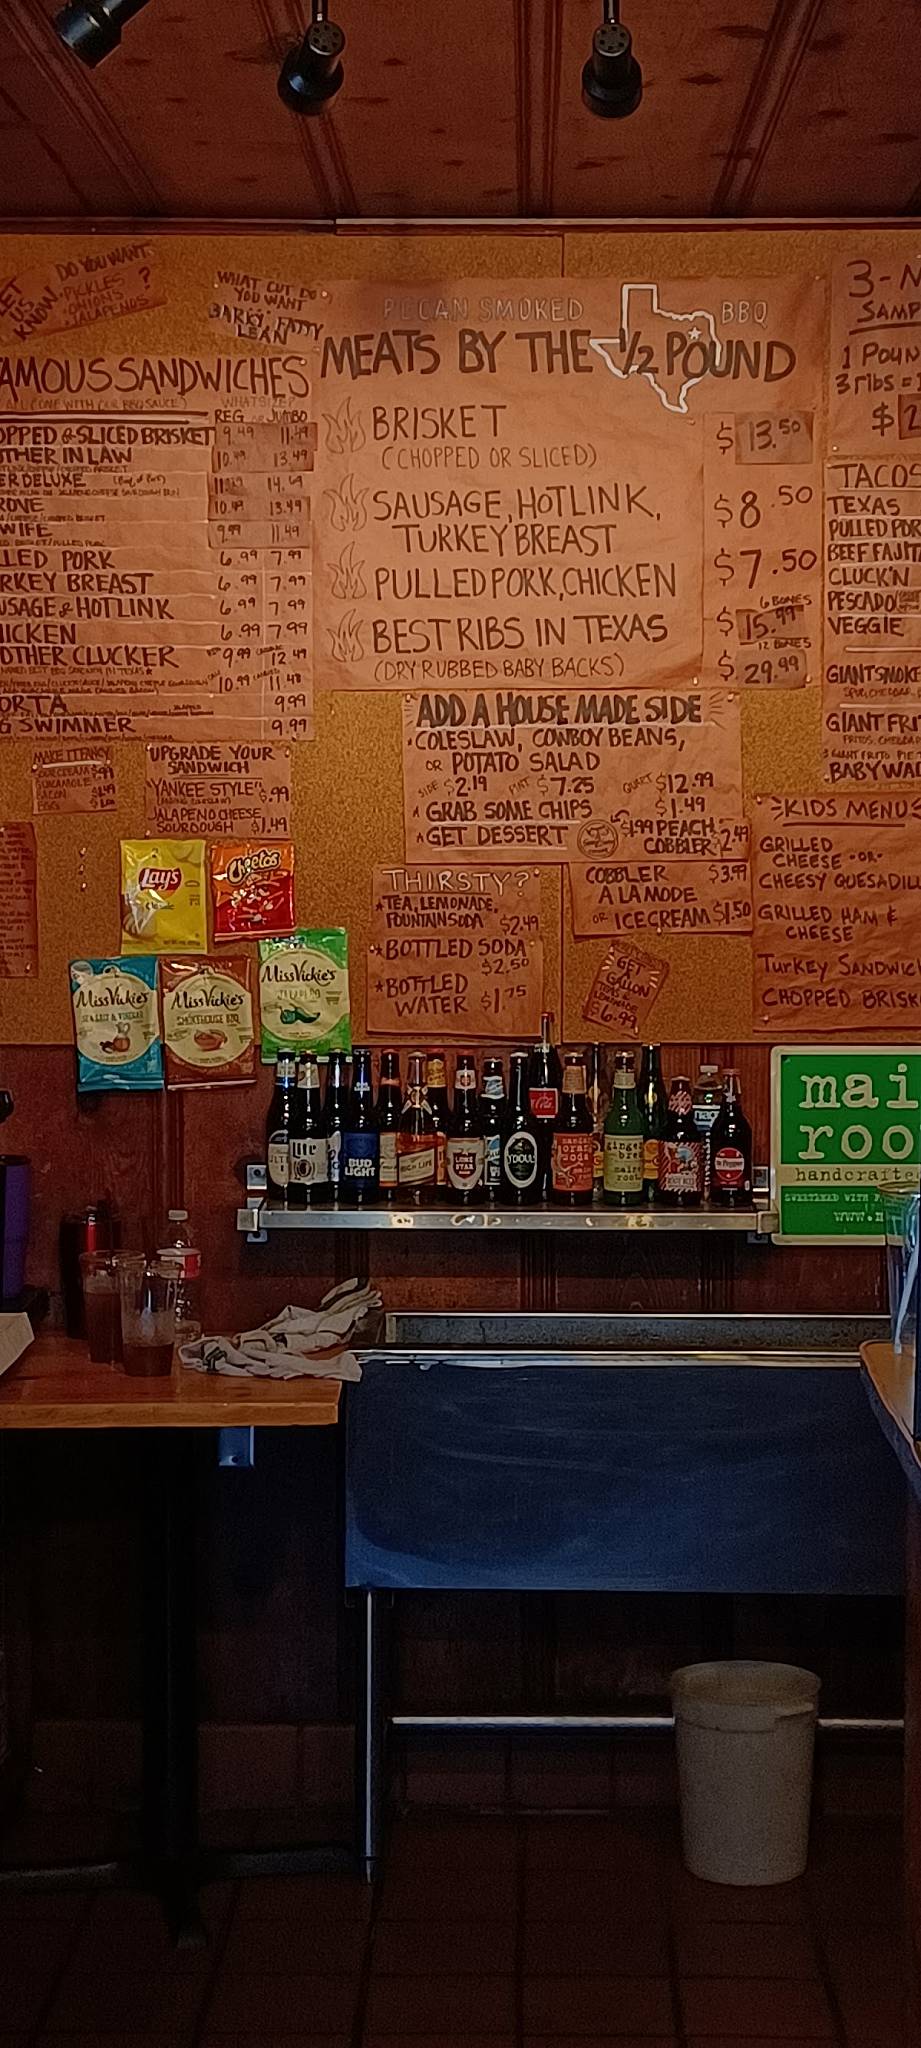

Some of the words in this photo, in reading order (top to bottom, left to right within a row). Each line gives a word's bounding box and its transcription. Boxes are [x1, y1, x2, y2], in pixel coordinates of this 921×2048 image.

[217, 271, 261, 291] WHAT
[266, 281, 294, 296] CUT
[233, 287, 261, 303] YOU
[264, 294, 308, 312] WANT
[383, 298, 469, 320] PECAN
[478, 298, 584, 321] SMOKED
[722, 301, 768, 328] BBQ
[236, 323, 288, 345] LEAN
[320, 329, 441, 381] MEATS
[458, 328, 507, 374] BY
[515, 329, 594, 375] THE
[666, 331, 797, 383] POUND
[115, 355, 310, 399] SANDWICHES
[214, 409, 245, 424] REG
[267, 408, 309, 424] JUMBO
[371, 404, 508, 442] BRISKET
[76, 425, 140, 445] SLICED
[141, 426, 217, 447] BRISKET
[63, 447, 84, 465] IN
[88, 446, 133, 466] LAW
[382, 445, 480, 471] (CHOPPED
[489, 447, 512, 469] OR
[518, 443, 598, 470] SLICED)
[22, 470, 87, 489] DELUXE
[372, 490, 513, 524] SAUSAGE,
[517, 482, 661, 521] HOTLINK,
[826, 494, 901, 517] TEXAS
[391, 523, 509, 558] TURKEY
[514, 523, 617, 558] BREAST
[828, 518, 889, 541] PULLED
[63, 549, 116, 572] PORK
[219, 550, 258, 567] 6.99
[828, 542, 870, 563] BEEF
[714, 547, 818, 590] $7.50
[828, 566, 910, 587] CLUCK'N
[67, 571, 155, 595] BREAST
[217, 574, 258, 592] 6.99
[269, 574, 307, 592] 7.99
[374, 566, 487, 601] PULLED
[491, 566, 564, 602] PORK,
[562, 562, 676, 599] CHICKEN
[76, 595, 176, 620] HOTLINK
[219, 596, 257, 616] 6.99
[268, 599, 307, 616] 7.99
[771, 595, 813, 608] BONES
[828, 591, 896, 613] PESCADO
[220, 623, 261, 641] 6.99
[267, 621, 309, 640] 7.99
[372, 617, 452, 654] BEST
[456, 615, 526, 652] RIBS
[535, 616, 566, 648] IN
[572, 613, 669, 644] TEXAS
[827, 616, 905, 637] VEGGIE
[72, 644, 180, 669] CLUCKER
[374, 658, 416, 683] (DRY
[421, 658, 499, 680] RUBBED
[503, 657, 546, 679] BABY
[551, 652, 625, 679] BACKS)
[826, 663, 875, 686] GIANT
[274, 693, 307, 714] 9.99
[416, 693, 467, 728] ADD
[471, 693, 491, 728] A
[496, 691, 570, 727] HOUSE
[574, 694, 641, 725] MADE
[644, 694, 702, 724] SIDE
[19, 716, 137, 734] SWIMMER
[271, 718, 308, 737] 9.99
[825, 711, 885, 733] GIANT
[415, 728, 523, 752] COLESLAW,
[532, 728, 604, 748] COWBOY
[608, 727, 686, 752] BEANS,
[149, 745, 221, 762] UPGRADE
[229, 744, 276, 761] YOUR
[425, 759, 443, 772] OR
[452, 751, 520, 775] POTATO
[529, 750, 601, 773] SALAD
[167, 760, 250, 775] SANDWICH
[829, 760, 882, 784] BABY
[258, 785, 290, 803] $.99
[418, 779, 439, 798] SIDE
[444, 775, 488, 797] $2.19
[508, 776, 531, 795] PINT
[536, 774, 595, 797] $7.25
[655, 771, 714, 797] $12.99
[147, 806, 217, 827] JALAPENO
[219, 807, 262, 821] CHEESE
[426, 800, 478, 823] GRAB
[484, 800, 533, 821] SOME
[538, 799, 593, 820] CHIPS
[655, 796, 706, 819] $1.49
[784, 798, 838, 818] KIDS
[845, 800, 908, 820] MENU
[156, 821, 235, 834] SOURDOUGH
[250, 816, 288, 834] $1.49
[426, 826, 468, 847] GET
[477, 826, 569, 847] DESSERT
[656, 817, 715, 838] PEACH
[643, 837, 717, 856] COBBLER
[759, 835, 834, 854] GRILLED
[226, 850, 280, 885] Cheetos
[772, 852, 843, 871] CHEESE
[381, 868, 529, 897] THIRSTY?
[585, 864, 669, 884] COBBLER
[708, 863, 747, 884] $3.99
[758, 872, 828, 892] CHEESY
[382, 894, 419, 913] TEA,
[420, 894, 498, 914] LEMONADE,
[598, 885, 614, 905] A
[618, 884, 642, 904] LA
[644, 886, 698, 904] MODE
[386, 911, 447, 929] FOUNTAIN
[448, 911, 484, 929] SODA
[500, 914, 539, 936] $2.49
[592, 912, 608, 924] OR
[615, 910, 647, 930] ICE
[647, 906, 711, 929] CREAM
[712, 900, 751, 926] $1.50
[757, 903, 833, 924] GRILLED
[840, 907, 879, 927] HAM
[886, 904, 898, 928] &
[785, 925, 855, 944] CHEESE
[385, 937, 473, 961] BOTTLED
[478, 938, 527, 958] SODA
[262, 964, 297, 983] Miss
[291, 959, 337, 987] Vickie's
[481, 957, 529, 977] $2.50
[616, 955, 647, 977] GET
[386, 973, 469, 999] BOTTLED
[606, 971, 651, 998] GALLON
[76, 990, 109, 1010] Miss
[105, 986, 150, 1010] Vickie's
[171, 990, 203, 1010] Miss
[198, 985, 245, 1011] Vickie's
[395, 995, 469, 1018] WATER
[480, 984, 527, 1014] $1.75
[761, 986, 851, 1010] CHOPPED
[799, 1063, 919, 1109] mai
[798, 1124, 915, 1160] roo
[344, 1167, 376, 1177] LIGHT
[348, 1158, 373, 1168] BUD
[455, 1163, 475, 1171] STAR
